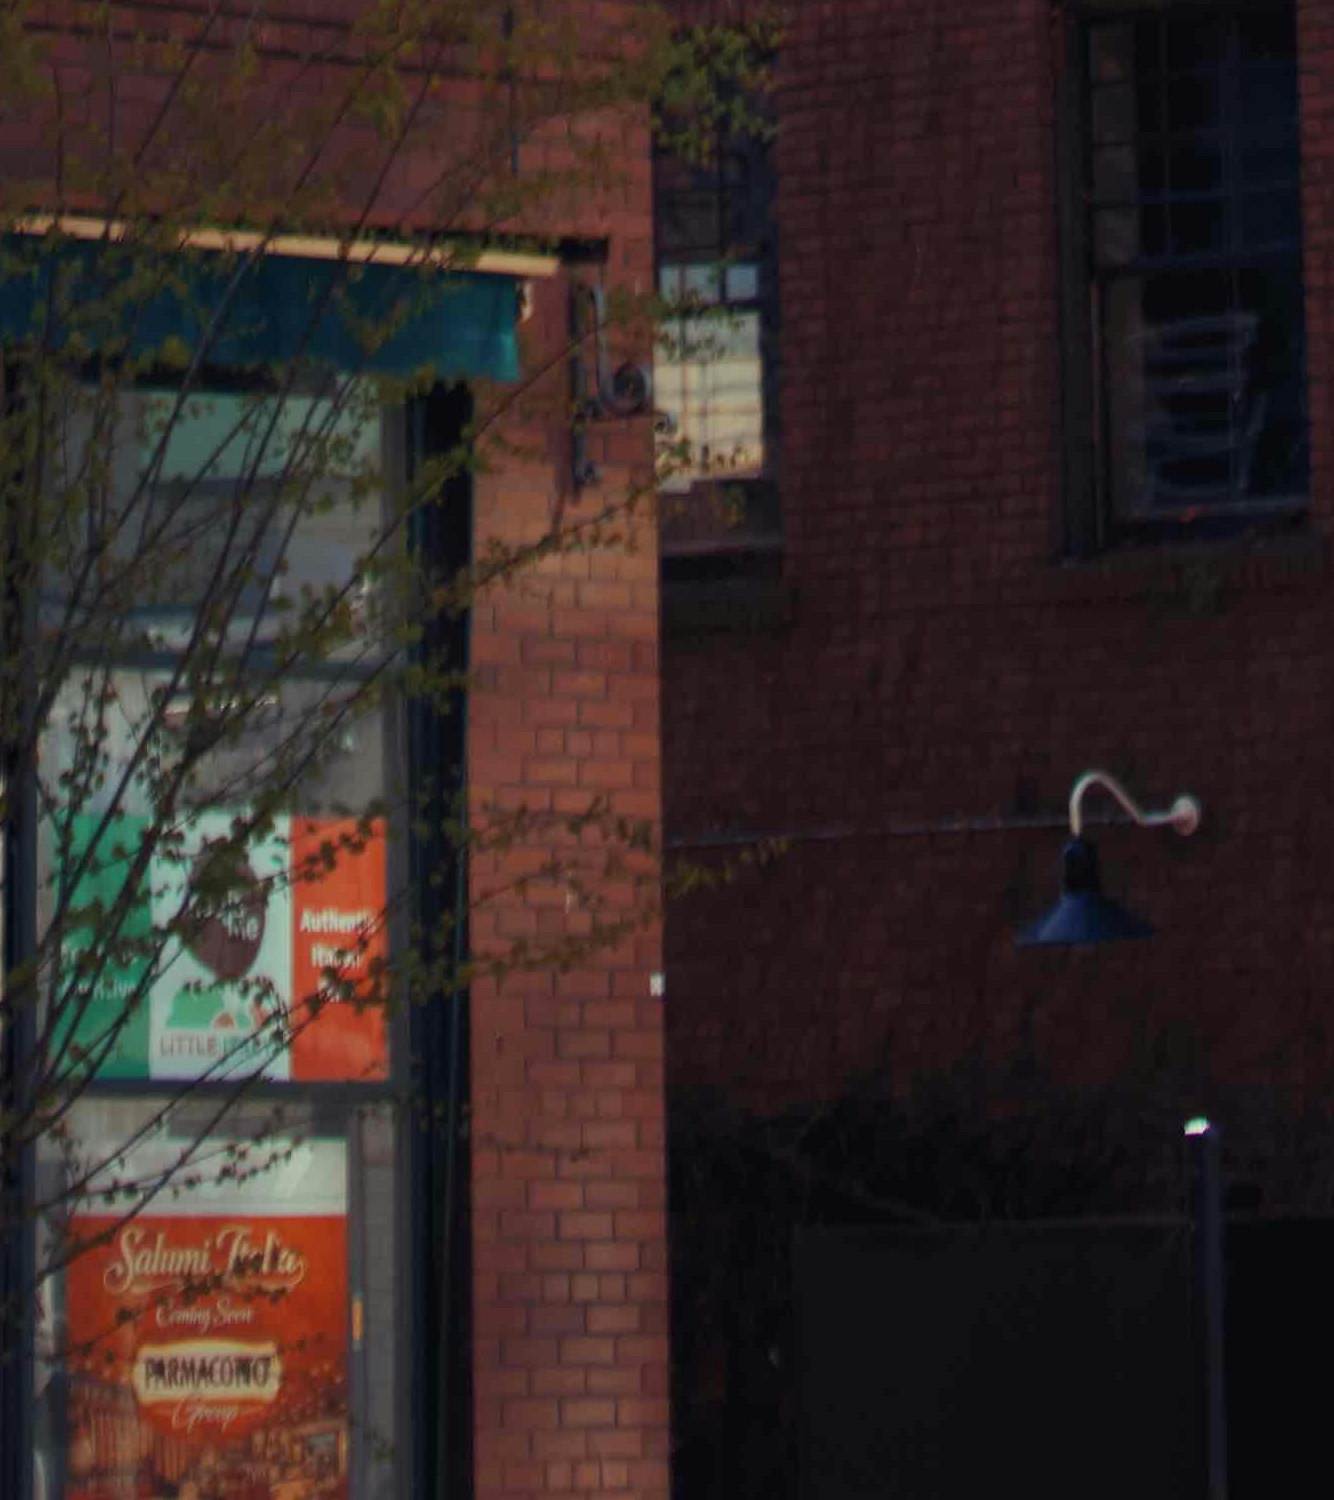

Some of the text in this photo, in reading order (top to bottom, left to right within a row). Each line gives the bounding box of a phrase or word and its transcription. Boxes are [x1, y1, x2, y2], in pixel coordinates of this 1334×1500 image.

[160, 1034, 218, 1057] LITTLE
[104, 1226, 211, 1294] Salumi
[155, 1297, 254, 1332] Coming Soon
